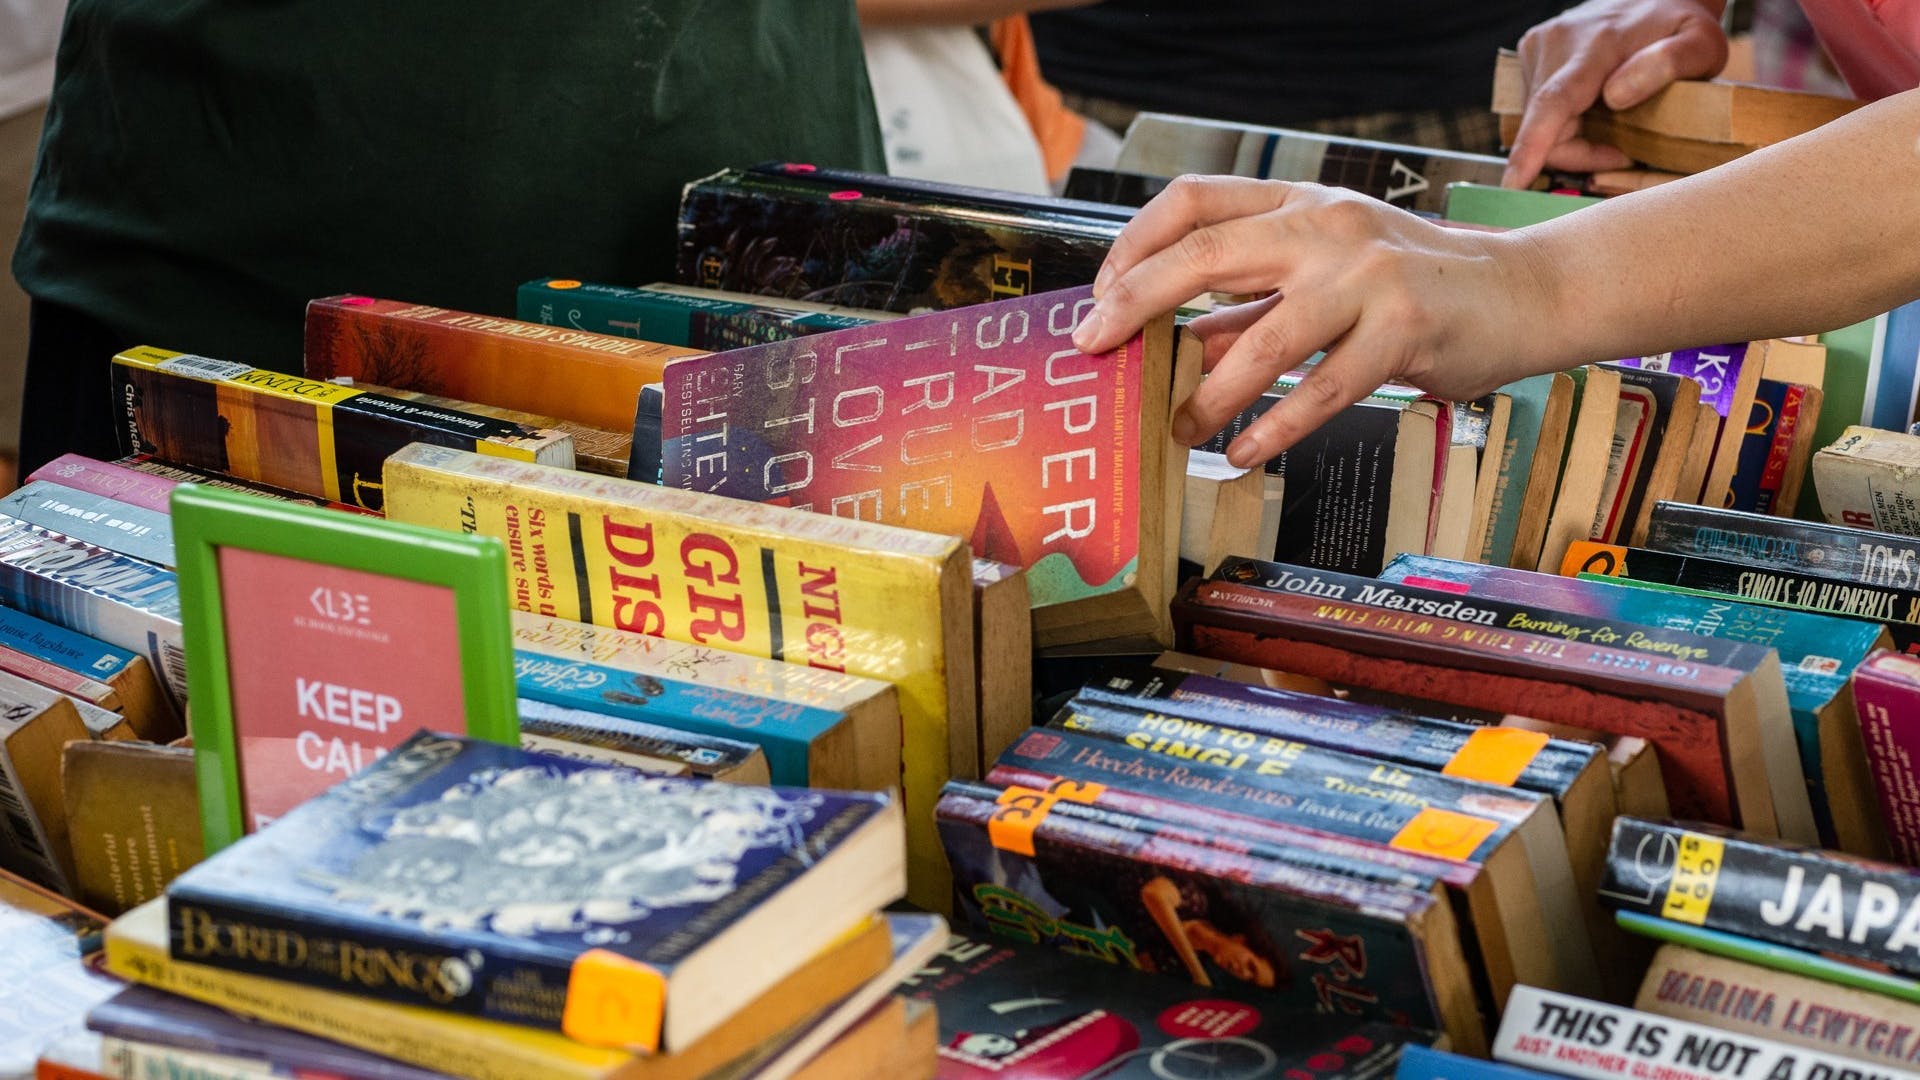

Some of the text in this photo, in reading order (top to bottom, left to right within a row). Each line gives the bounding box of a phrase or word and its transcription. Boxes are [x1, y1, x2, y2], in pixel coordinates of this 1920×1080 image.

[440, 314, 551, 340] KENEALLY
[548, 331, 645, 356] THOMAS
[125, 383, 136, 418] Chris
[732, 363, 745, 398] GARY
[972, 309, 1030, 452] SAD
[355, 395, 405, 414] Victoria
[414, 410, 486, 430] Vancouver
[900, 321, 958, 517] TRUE
[1042, 297, 1099, 546] SUPER
[1113, 388, 1126, 448] BRILLIANTLY
[763, 349, 818, 512] STO
[831, 338, 888, 521] LOVE
[505, 504, 527, 573] ensure
[527, 507, 546, 538] Six
[1328, 504, 1339, 545] photograph
[532, 543, 555, 600] words
[602, 514, 666, 639] DIS
[1317, 545, 1325, 565] Cover
[1325, 546, 1334, 566] Cover
[1859, 541, 1917, 591] SAUL
[679, 532, 746, 645] GR
[1737, 571, 1795, 604] STONES
[1797, 580, 1817, 608] OF
[1818, 583, 1899, 621] STRENGTH
[1266, 570, 1711, 661] John Marsden Burning for Revenge
[1313, 604, 1367, 626] FINN
[1377, 613, 1434, 635] WITH
[1442, 625, 1516, 650] THING
[515, 656, 607, 688] Godfathe
[1523, 639, 1564, 659] THE
[296, 677, 403, 734] KEEP
[296, 730, 392, 777] CAL
[1136, 712, 1308, 761] HOW TO BE
[1071, 746, 1165, 784] Heechee
[1163, 765, 1297, 809] Rendezvous
[124, 835, 147, 902] venture
[140, 803, 164, 896] ertainment
[1671, 838, 1701, 910] LET'S
[1694, 857, 1717, 901] GO
[1656, 967, 1777, 1028] MARINA
[1512, 1035, 1551, 1054] JUST
[1553, 1042, 1628, 1073] ANOTHER
[1533, 1001, 1619, 1048] THIS
[1624, 1022, 1668, 1058] IS
[1675, 1033, 1759, 1077] NOT
